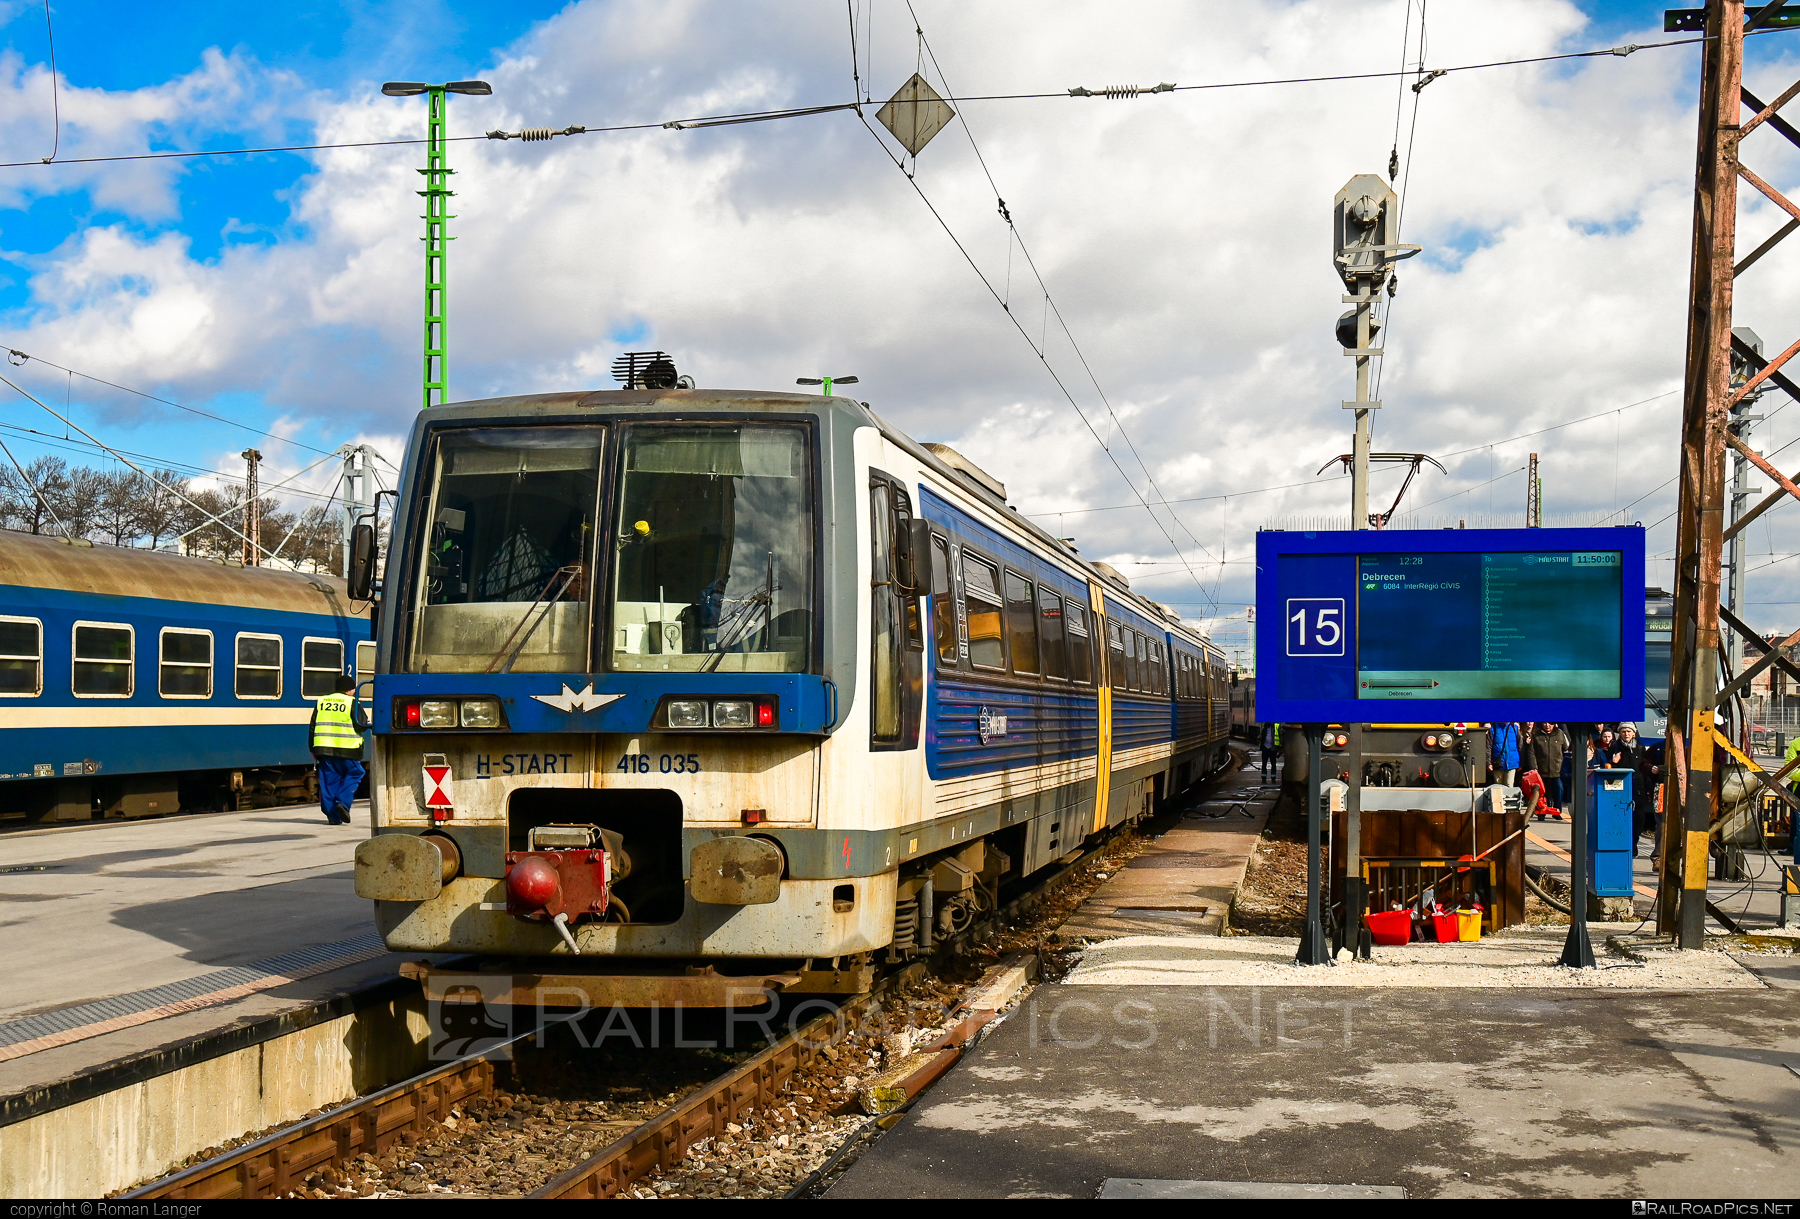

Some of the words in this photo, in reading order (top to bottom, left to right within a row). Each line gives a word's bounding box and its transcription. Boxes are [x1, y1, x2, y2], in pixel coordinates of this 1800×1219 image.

[1399, 557, 1423, 565] 12:28
[1577, 555, 1616, 563] 11:50:00
[1362, 573, 1406, 581] Debrecen
[1383, 582, 1400, 590] 6084
[1403, 582, 1439, 591] InterRégió
[1440, 581, 1461, 590] CÍVIS
[1290, 608, 1341, 646] 15
[347, 664, 352, 678] 2
[319, 702, 347, 713] 1230
[1653, 719, 1668, 727] H-ST
[476, 754, 573, 780] H-START
[617, 754, 650, 774] 416
[659, 754, 700, 774] 035
[885, 846, 891, 867] 2
